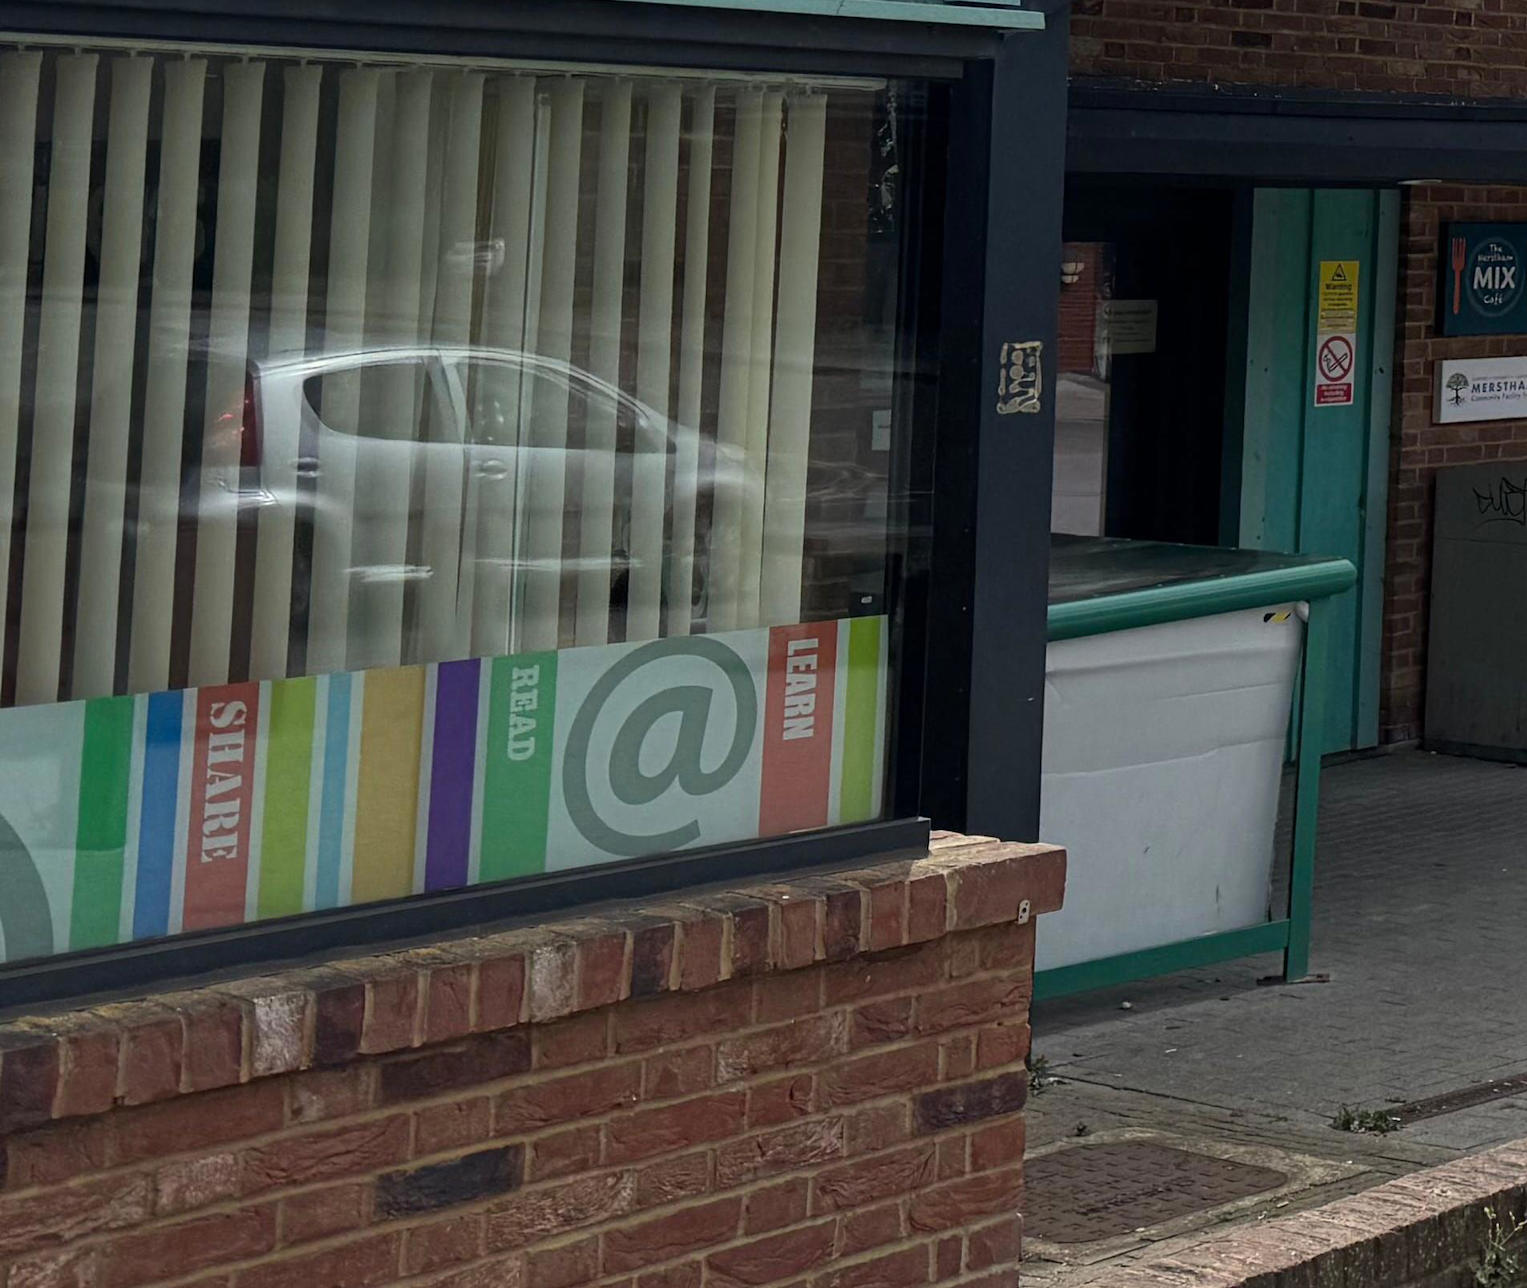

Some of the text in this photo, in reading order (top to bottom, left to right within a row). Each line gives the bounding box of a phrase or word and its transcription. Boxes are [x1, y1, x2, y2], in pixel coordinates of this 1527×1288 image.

[1473, 266, 1516, 290] MIX
[1490, 244, 1502, 253] The
[507, 665, 540, 761] READ
[783, 638, 819, 741] LEARN
[201, 701, 248, 863] SHARE
[562, 635, 758, 857] @
